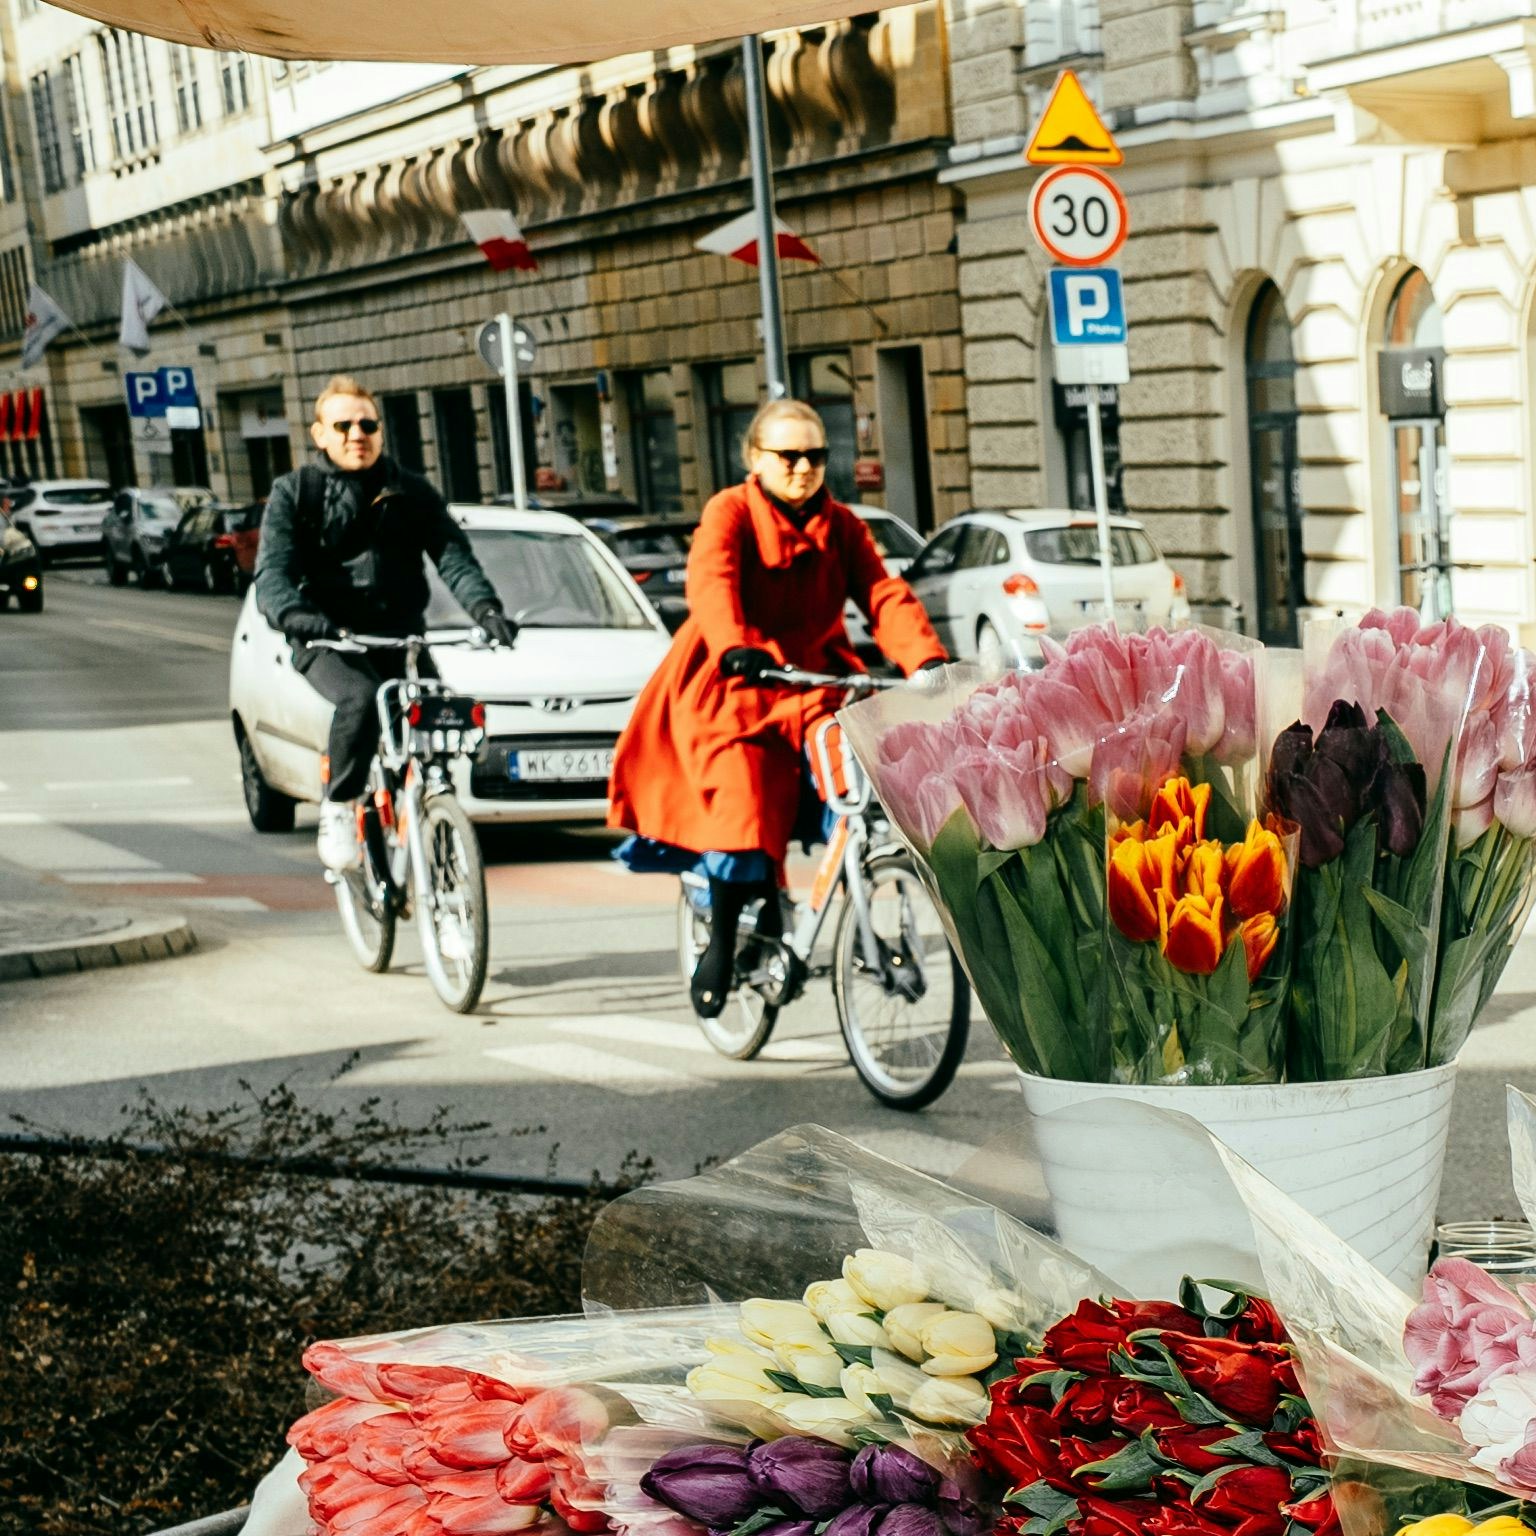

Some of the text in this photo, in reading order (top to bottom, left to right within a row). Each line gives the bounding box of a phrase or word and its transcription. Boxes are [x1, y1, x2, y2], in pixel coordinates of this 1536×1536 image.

[1052, 193, 1109, 238] 30
[1064, 275, 1110, 336] P
[135, 376, 158, 404] P
[166, 370, 187, 396] P
